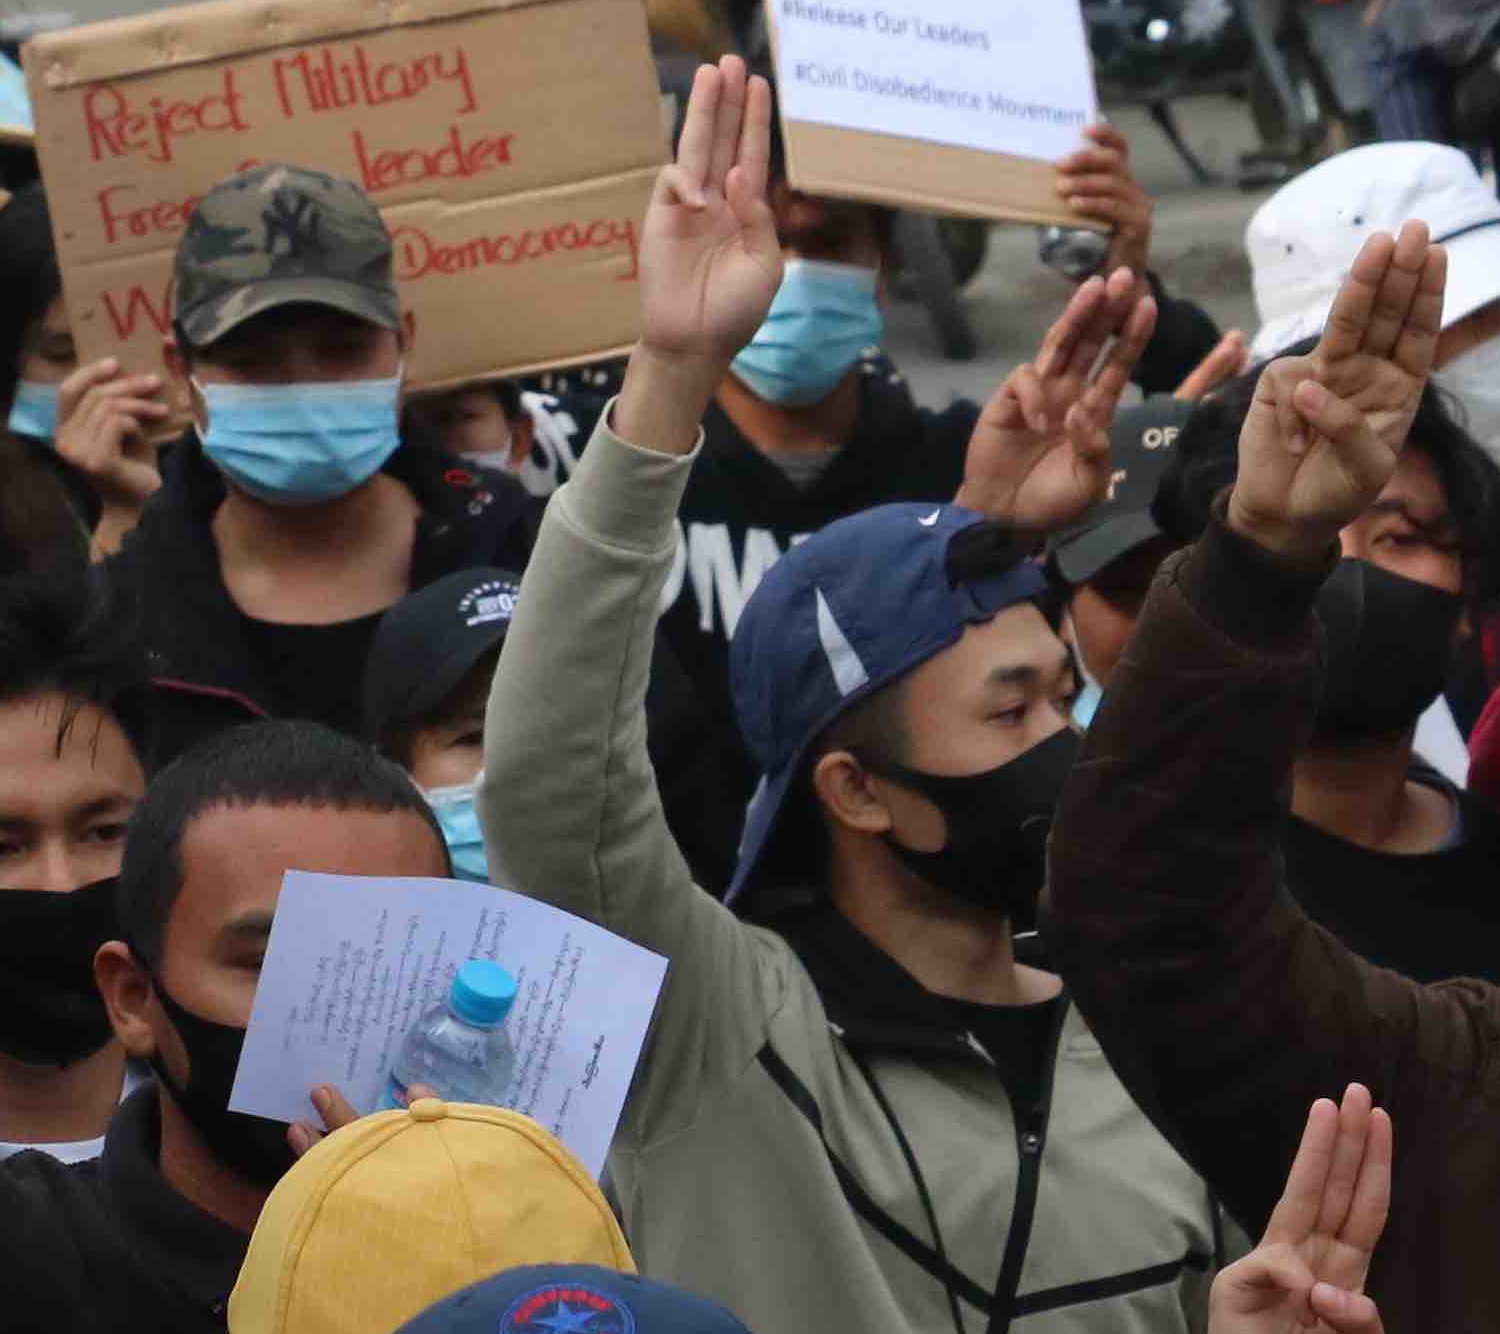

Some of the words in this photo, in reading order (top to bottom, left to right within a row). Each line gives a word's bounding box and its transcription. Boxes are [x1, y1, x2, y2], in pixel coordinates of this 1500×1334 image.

[872, 9, 909, 36] Our
[914, 18, 991, 51] Leaders
[82, 69, 250, 163] Reject
[271, 44, 478, 117] Military
[853, 69, 984, 113] Disobedience
[388, 211, 640, 283] Democracy
